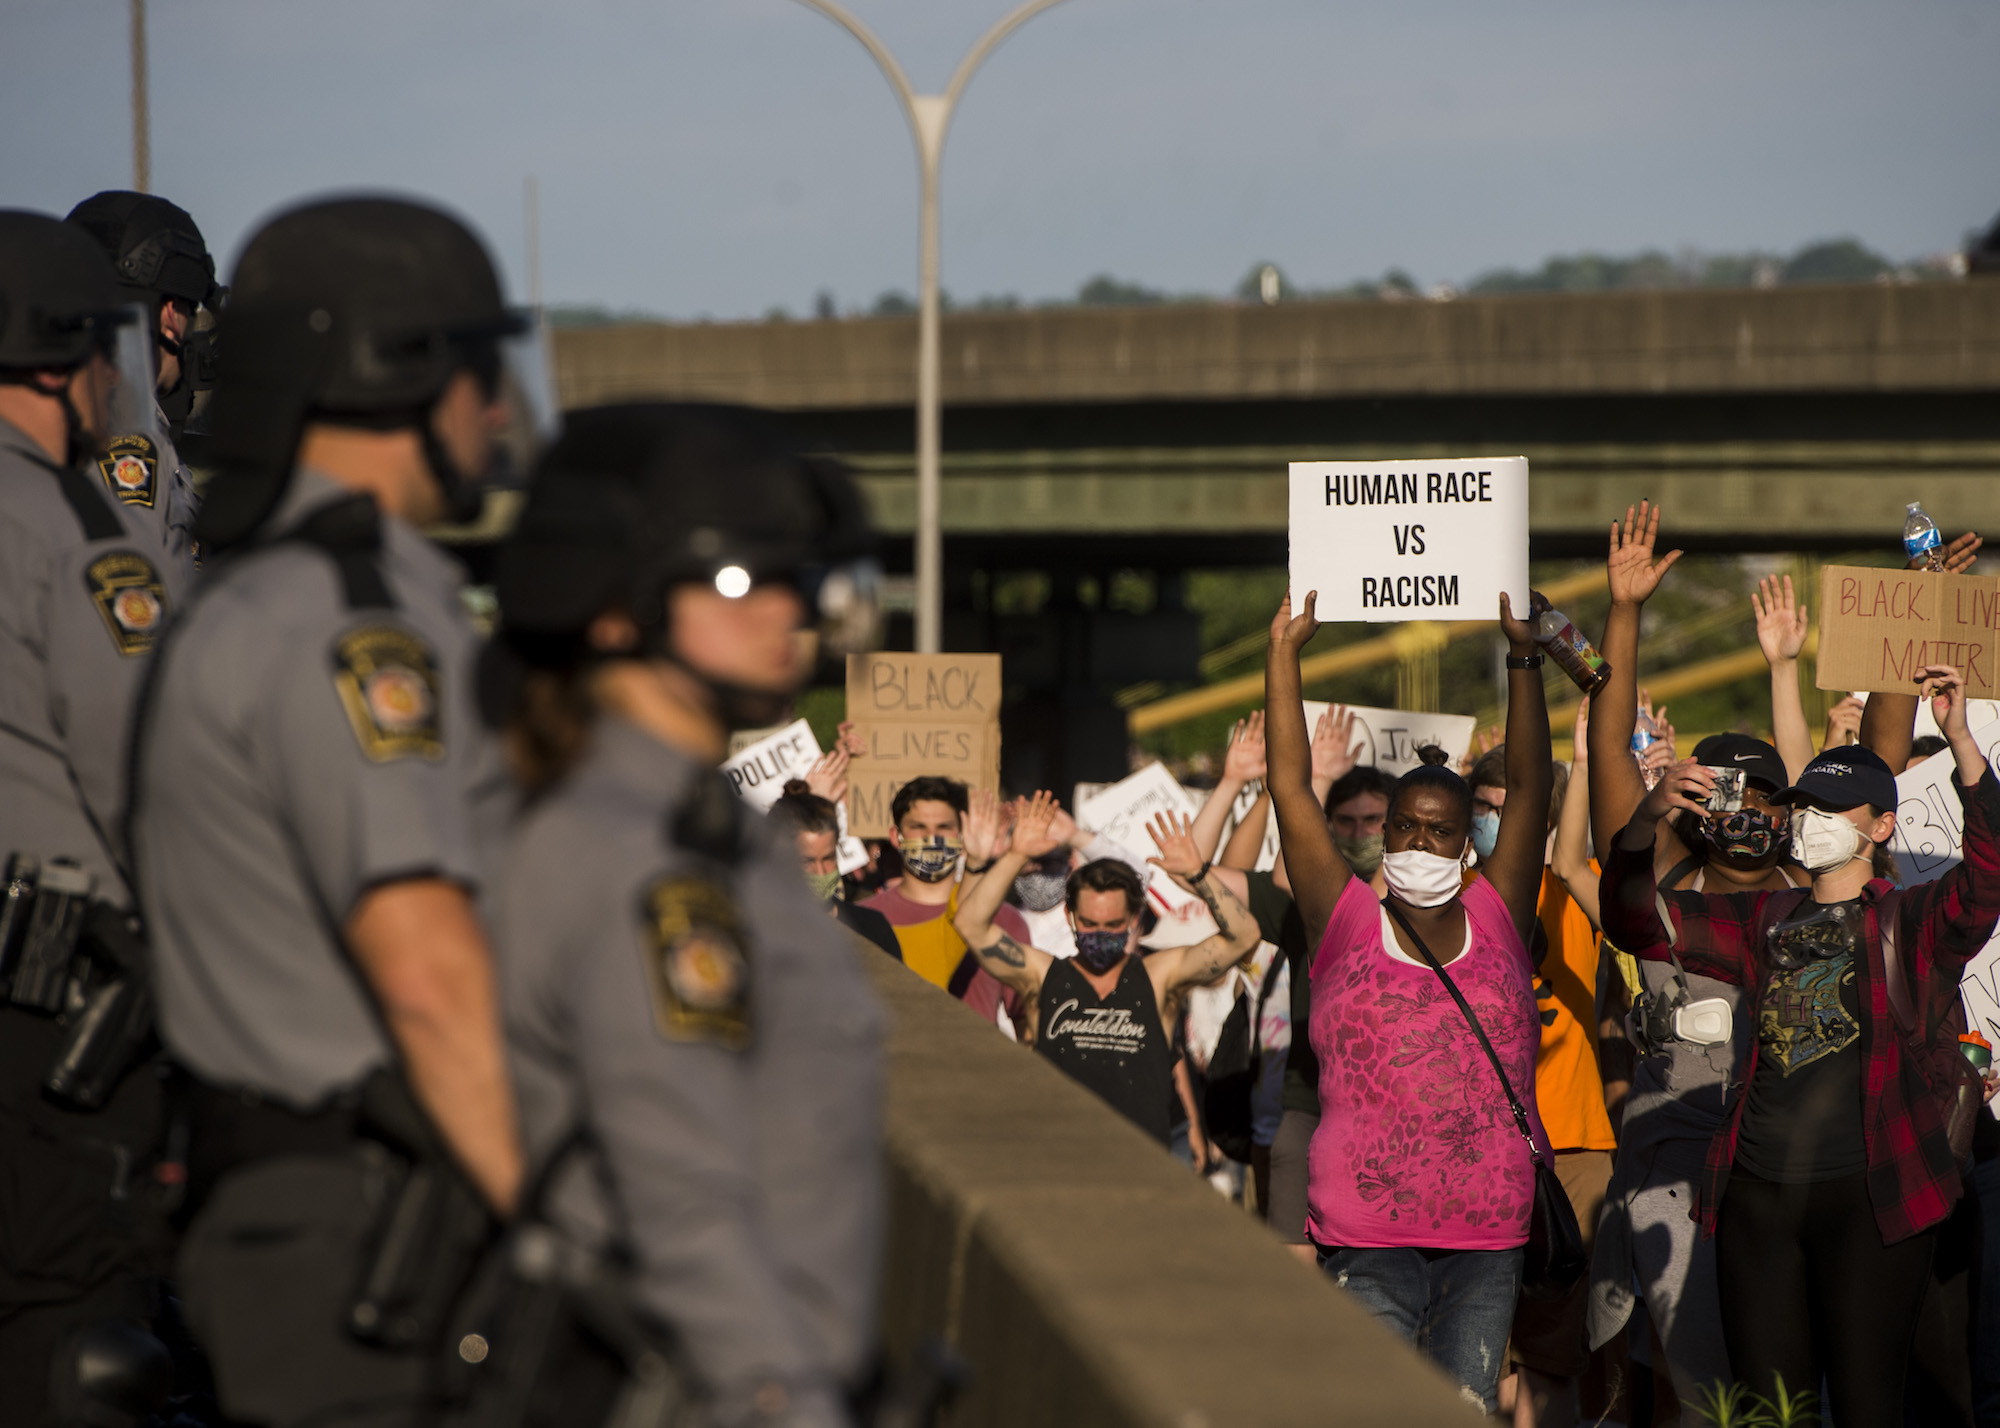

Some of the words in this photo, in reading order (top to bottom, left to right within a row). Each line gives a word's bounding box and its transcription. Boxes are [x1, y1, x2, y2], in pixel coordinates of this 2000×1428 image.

[1325, 473, 1417, 506] HUMAN
[1427, 471, 1493, 503] RACE
[1393, 524, 1426, 555] VS
[1362, 575, 1459, 608] RACISM
[1840, 577, 1931, 621] BLACK.
[1956, 588, 2000, 630] LIVE
[871, 661, 985, 712] BLACK
[872, 730, 972, 761] LIVES
[727, 732, 812, 797] POLICE
